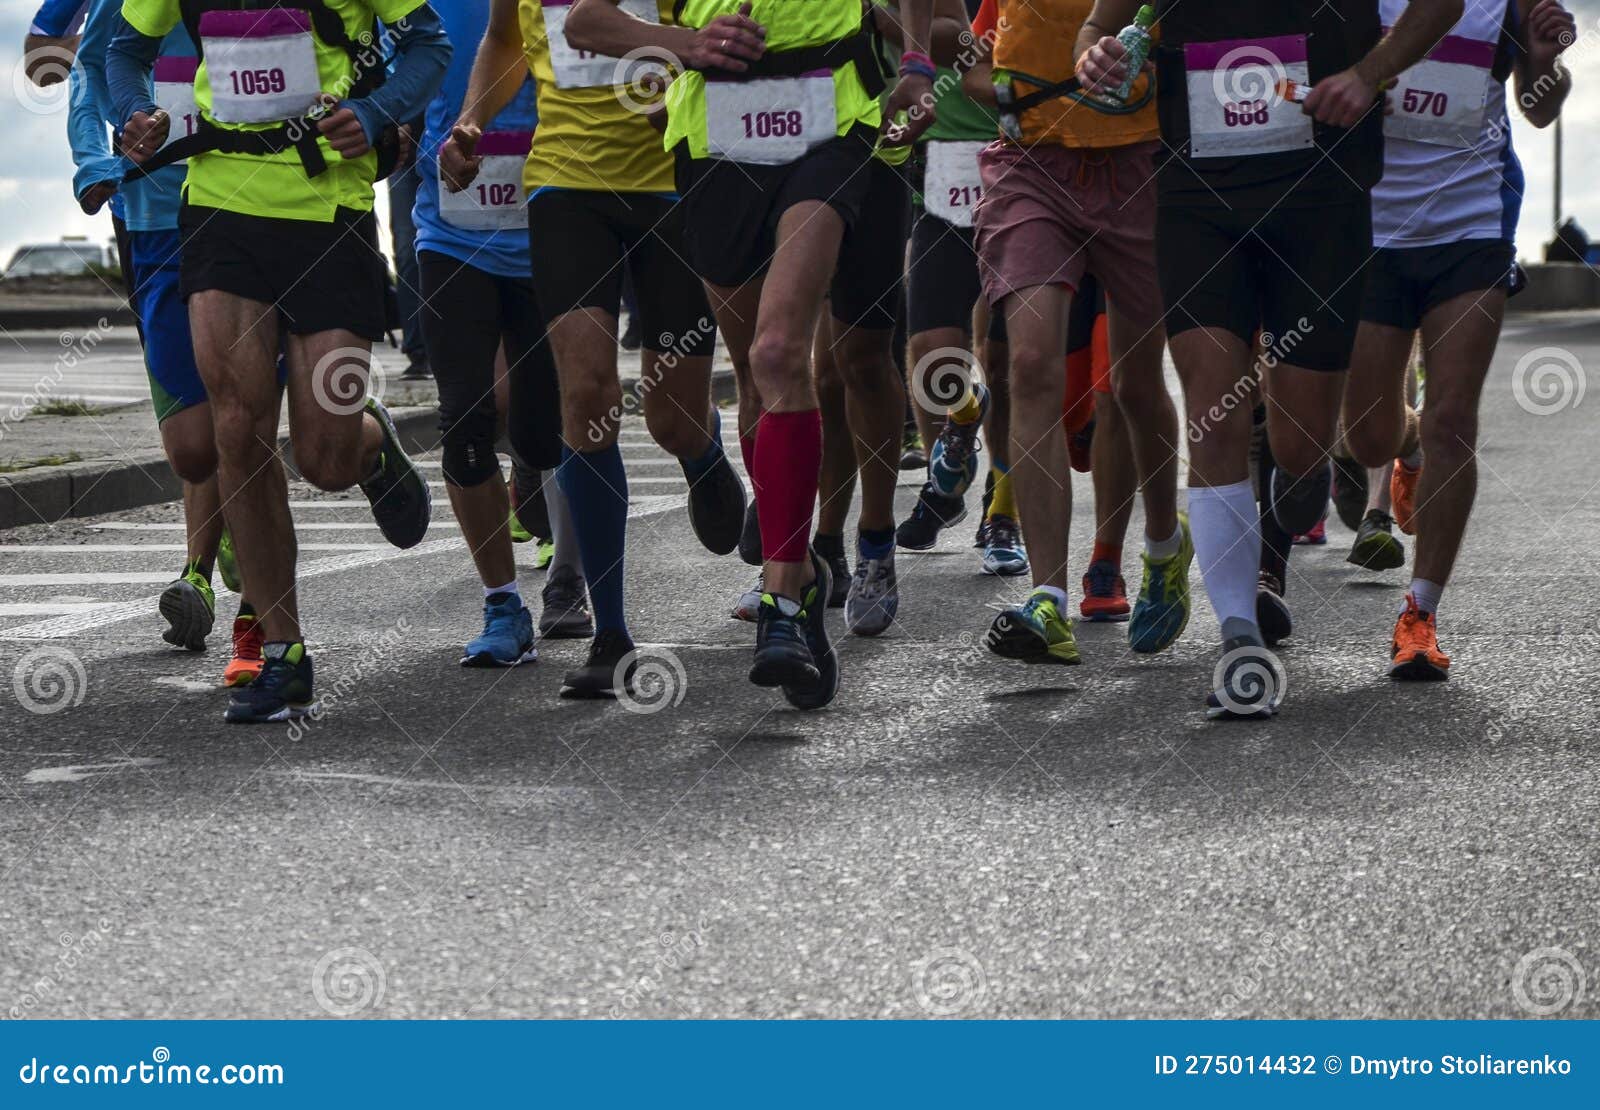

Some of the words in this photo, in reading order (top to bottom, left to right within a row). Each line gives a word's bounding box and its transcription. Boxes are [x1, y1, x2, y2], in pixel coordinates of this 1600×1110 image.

[230, 68, 286, 95] 1059
[1402, 88, 1448, 117] 570
[741, 110, 802, 138] 1058
[476, 184, 517, 206] 102
